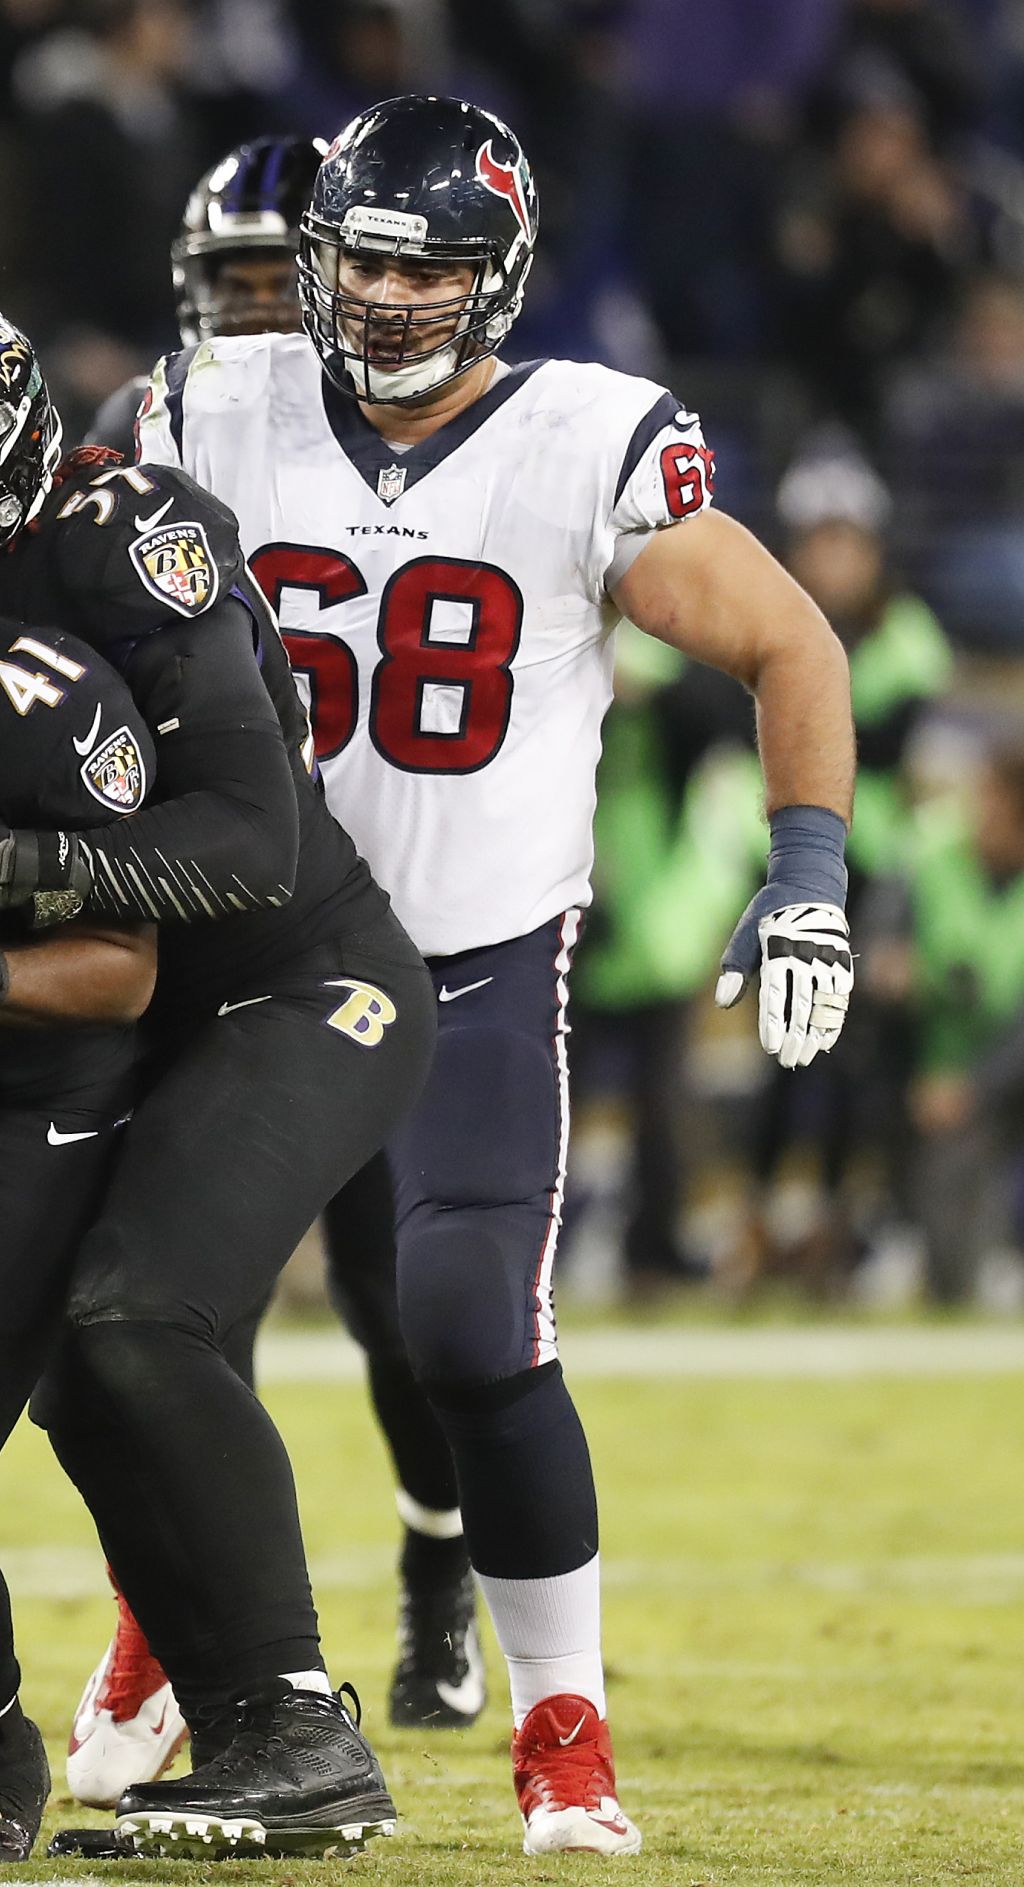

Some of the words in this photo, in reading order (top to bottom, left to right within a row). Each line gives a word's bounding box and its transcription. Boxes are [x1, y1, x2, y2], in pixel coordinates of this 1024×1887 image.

[368, 215, 407, 227] TEXANS
[659, 442, 715, 519] 6
[138, 528, 198, 555] RAVENS
[345, 525, 430, 540] TEXANS
[244, 541, 525, 776] 68
[87, 733, 128, 775] RAVENS
[322, 978, 397, 1048] B
